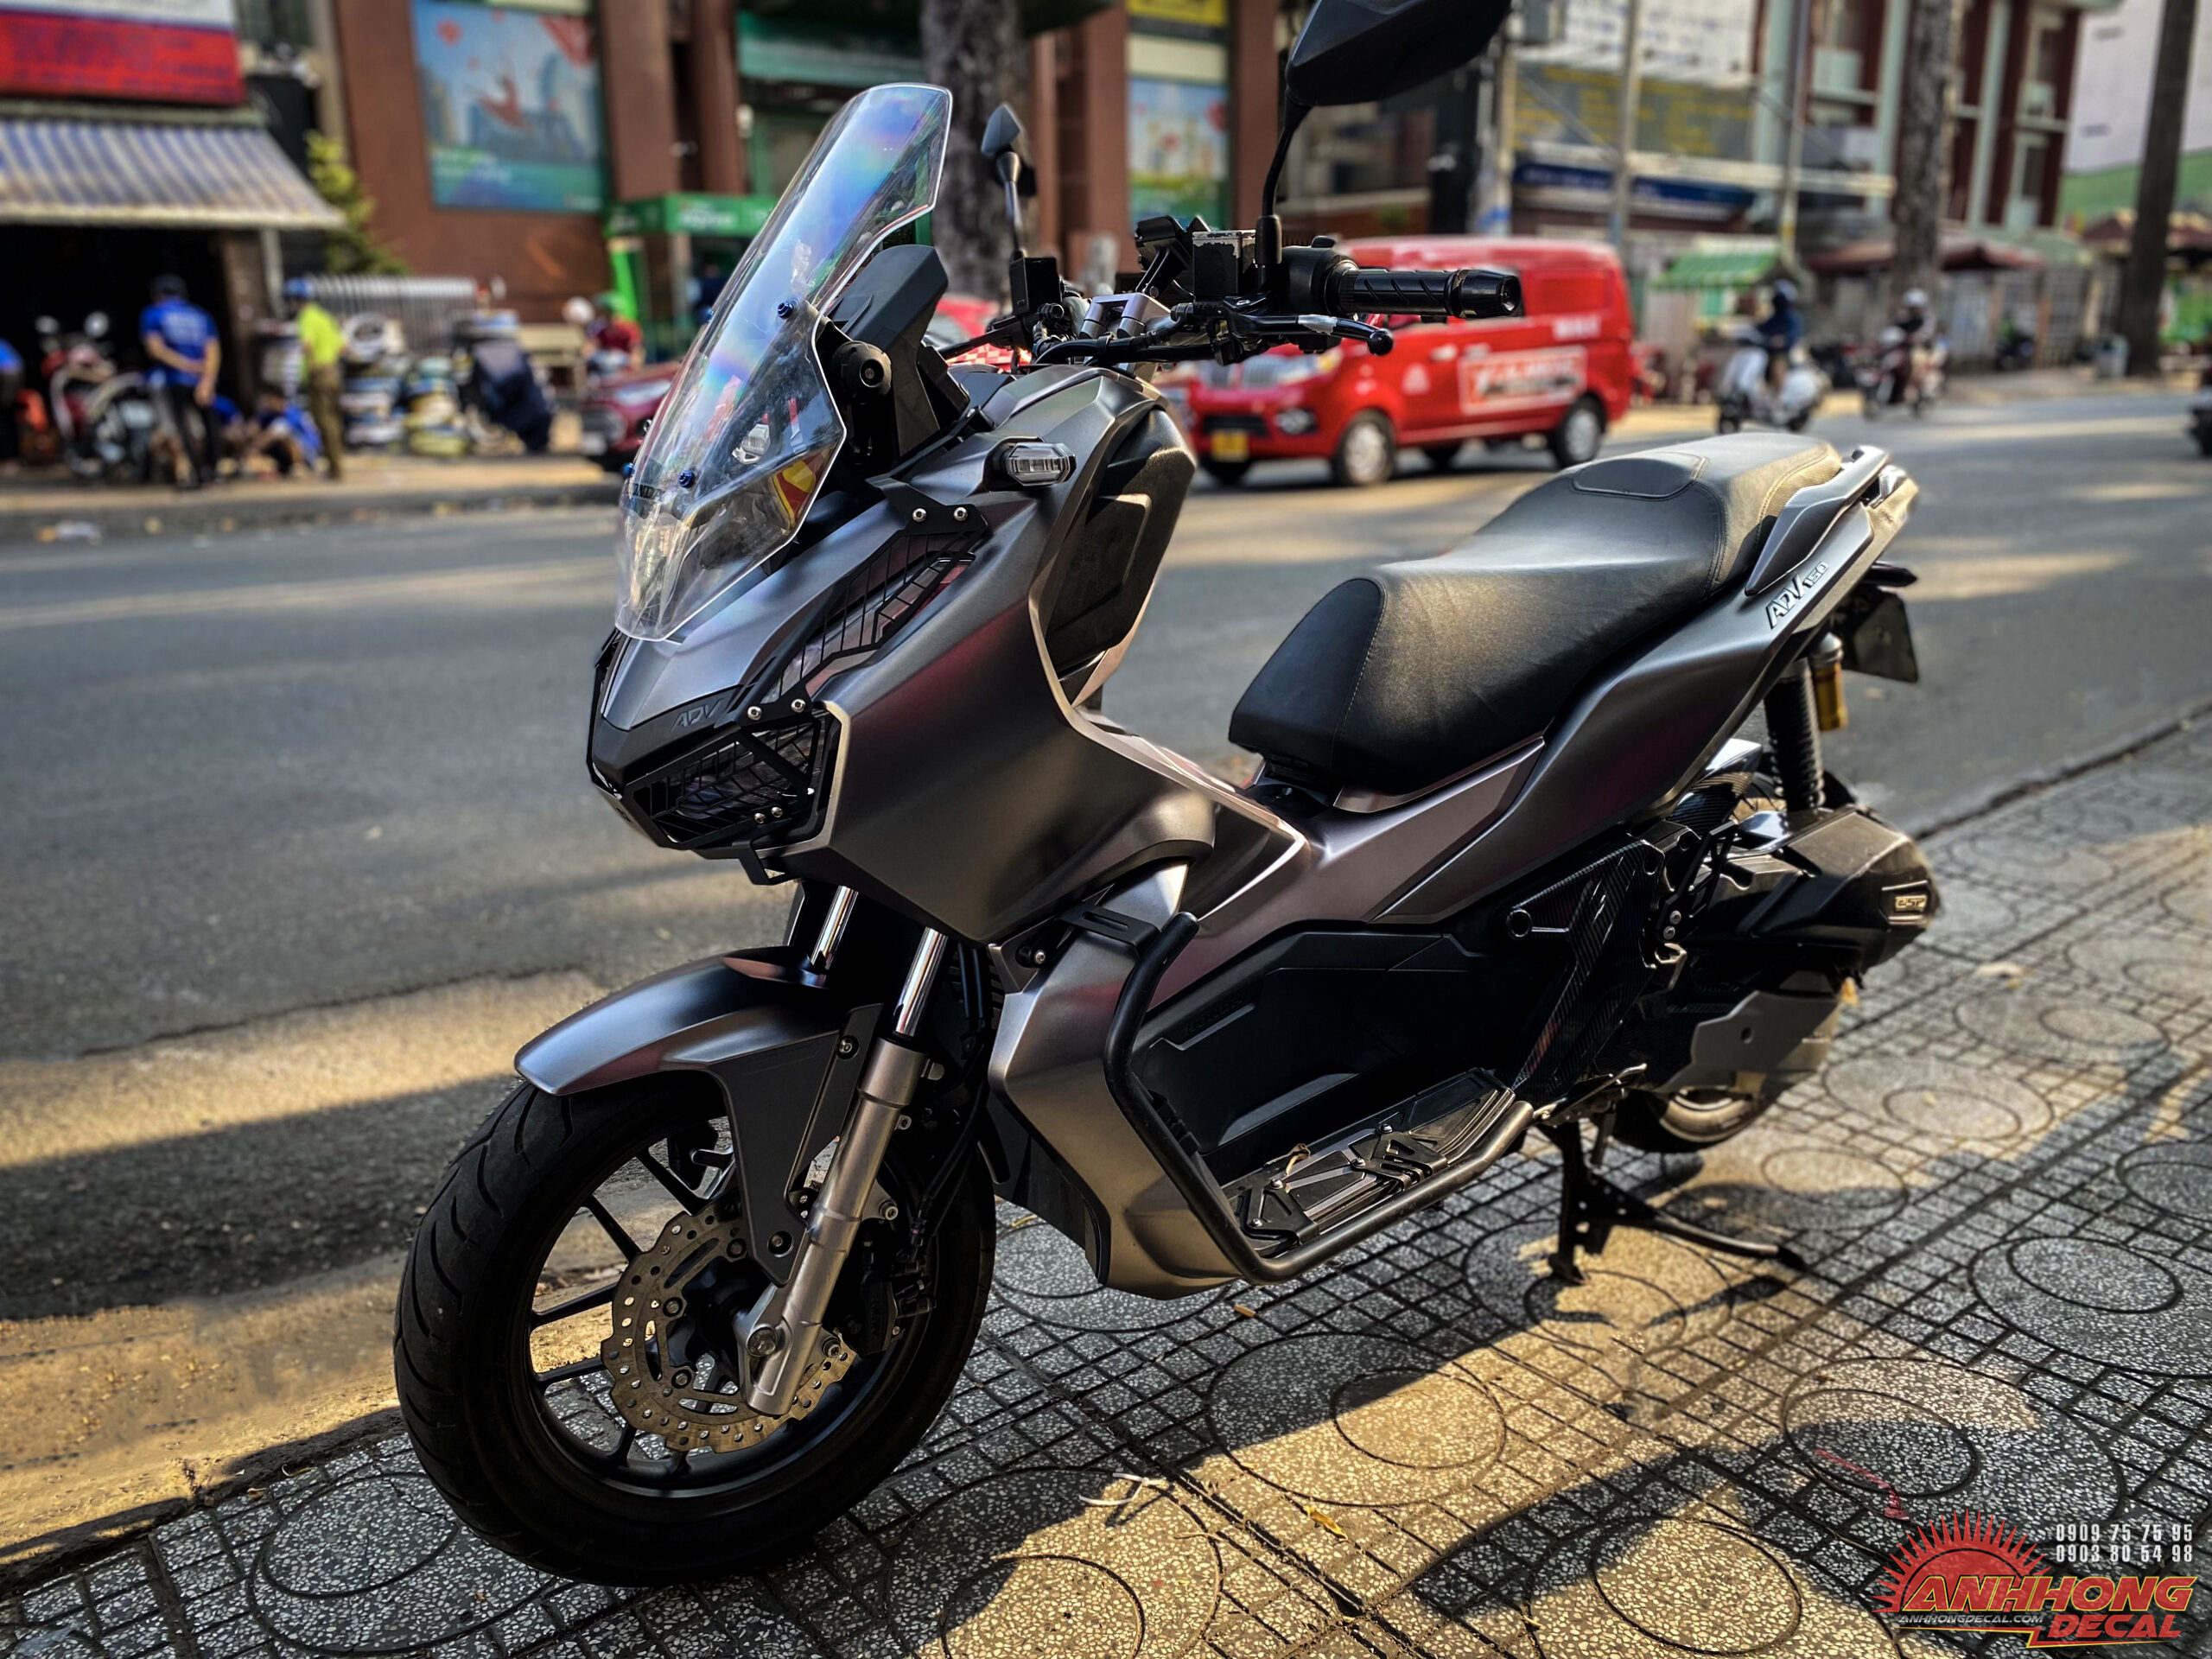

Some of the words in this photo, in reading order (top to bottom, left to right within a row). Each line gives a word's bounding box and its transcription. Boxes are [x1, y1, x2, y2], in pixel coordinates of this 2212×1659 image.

[1765, 574, 1806, 630] ADV
[1802, 561, 1829, 588] 150
[671, 698, 723, 733] ADV
